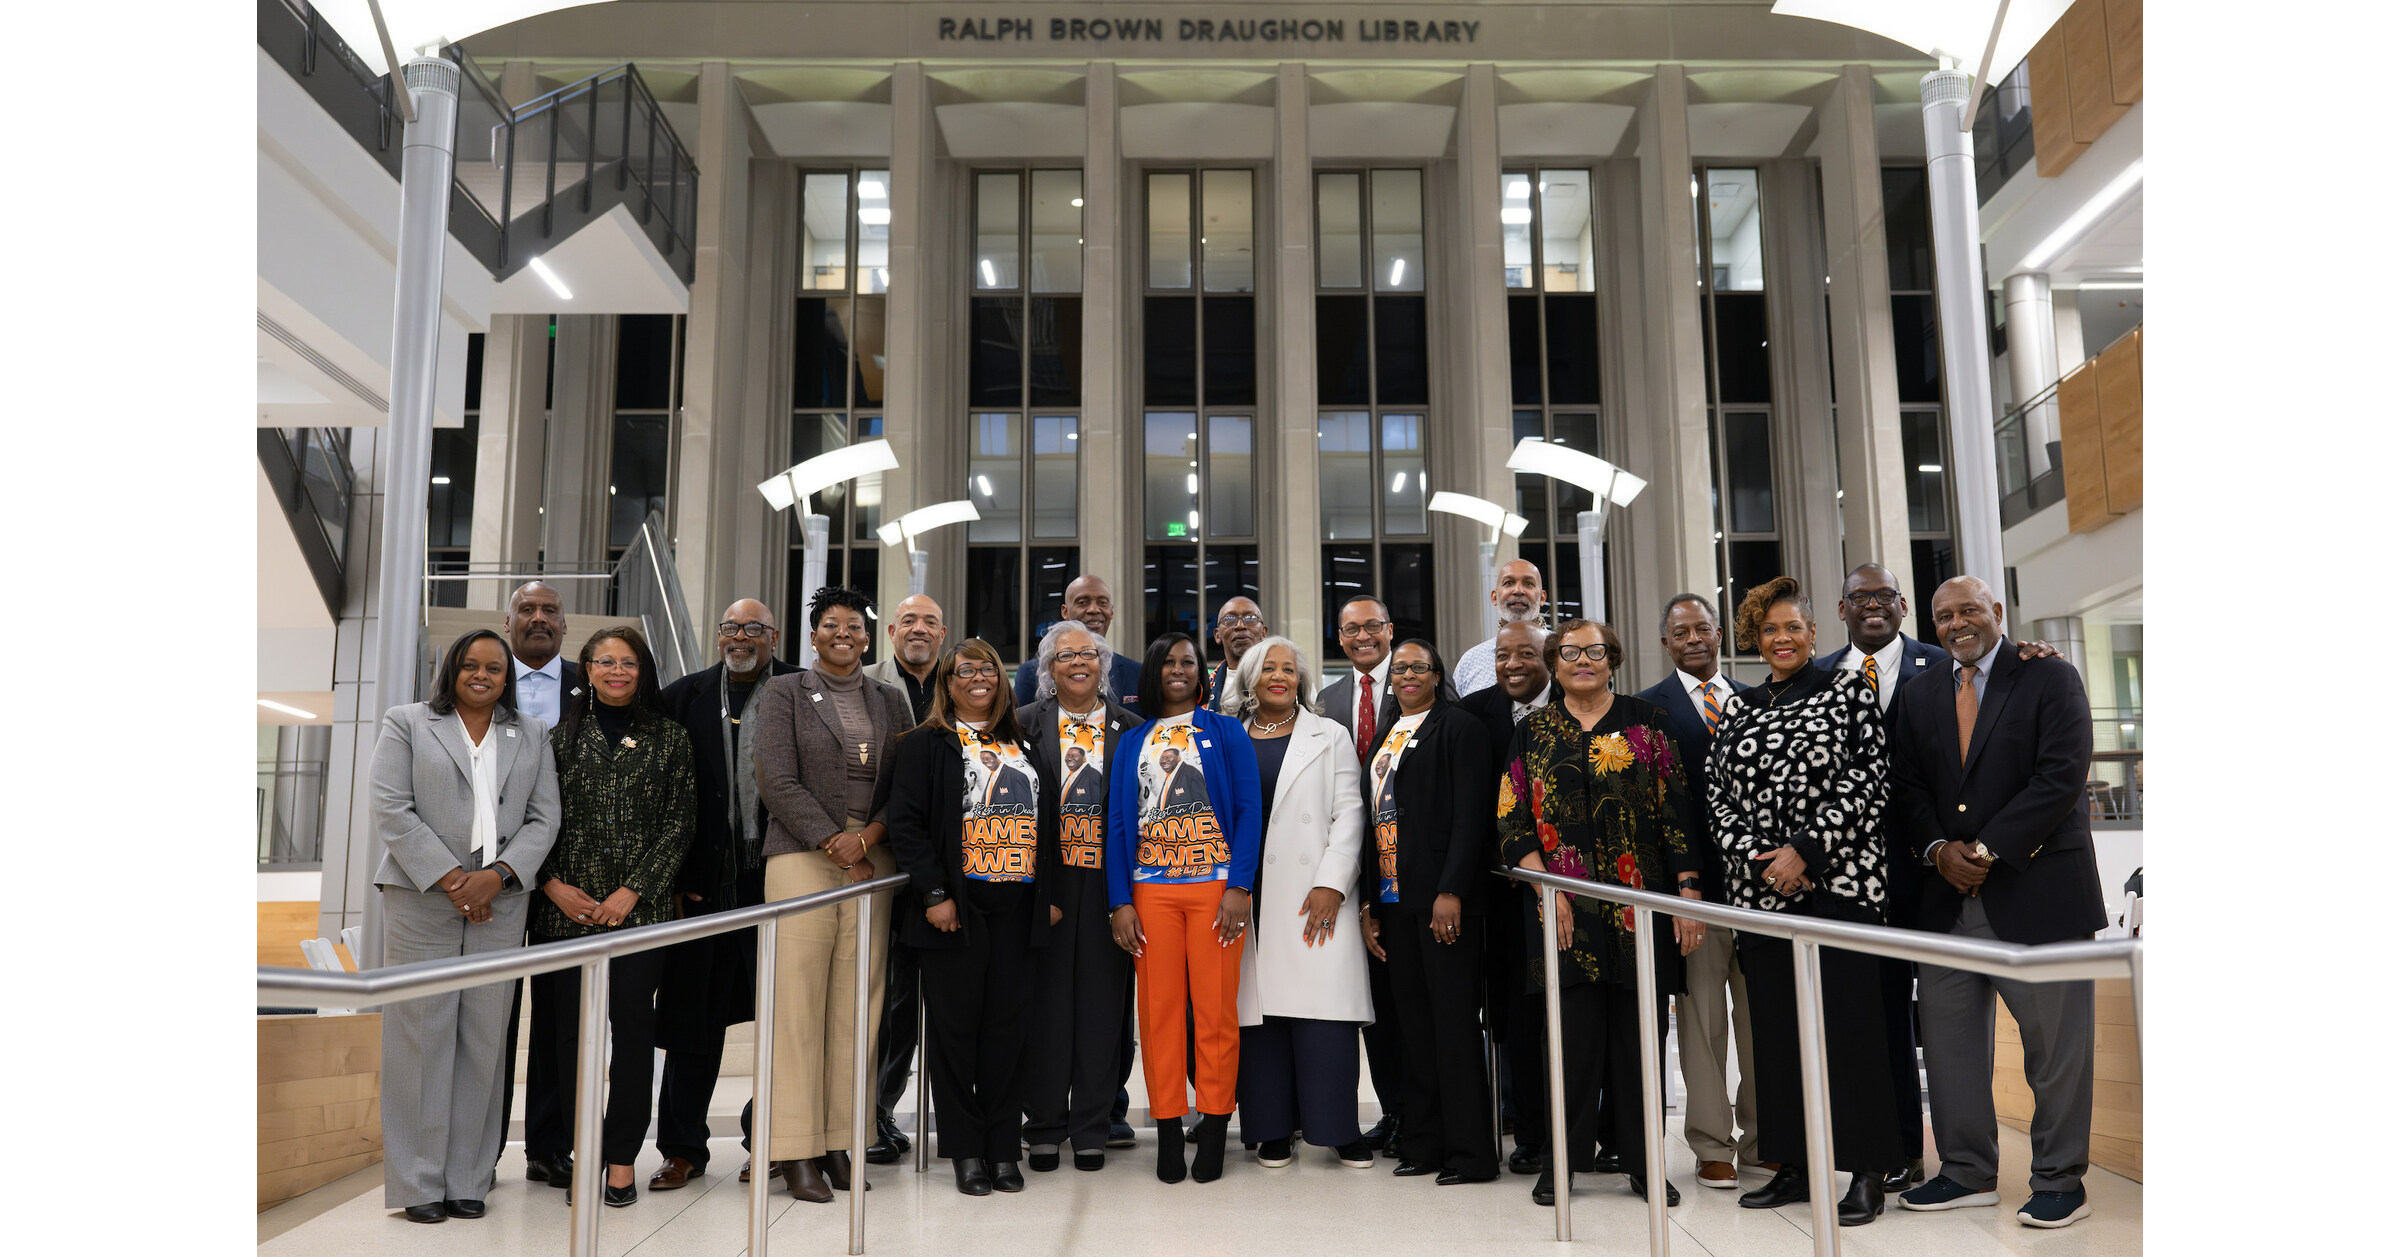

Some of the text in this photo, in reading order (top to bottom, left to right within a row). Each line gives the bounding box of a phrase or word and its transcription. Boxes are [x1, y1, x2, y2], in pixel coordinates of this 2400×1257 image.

[939, 18, 1480, 42] RALPH BROWN DRAUGHON LIBRARY
[973, 802, 1036, 819] Rest in Peac
[1149, 801, 1213, 823] Rest in Pea
[962, 818, 1037, 847] JAMES
[1166, 865, 1212, 877] #43
